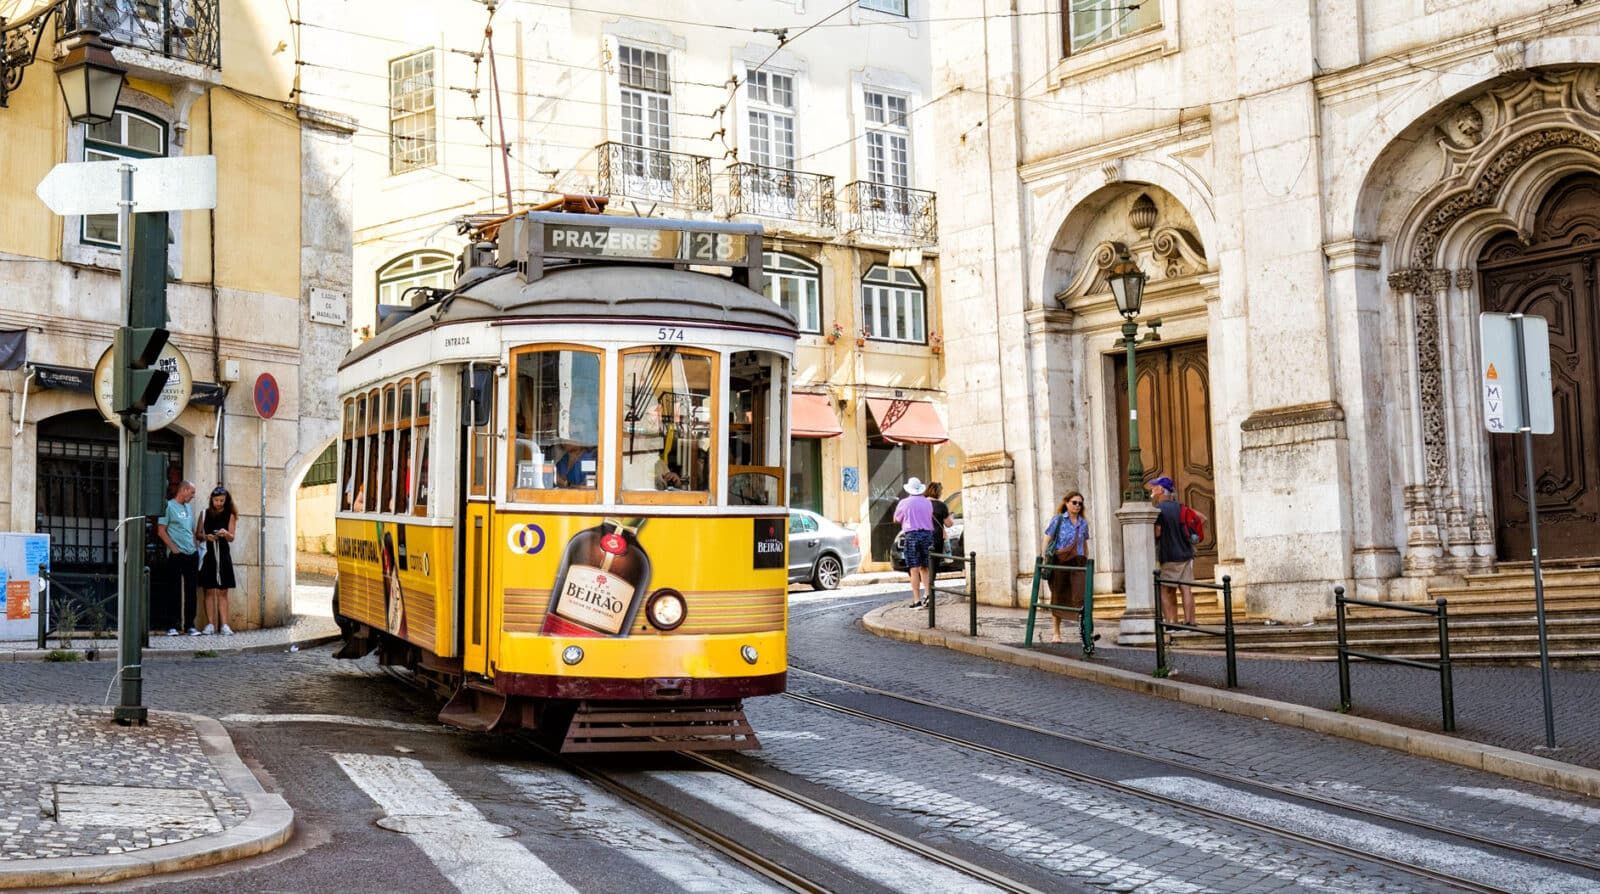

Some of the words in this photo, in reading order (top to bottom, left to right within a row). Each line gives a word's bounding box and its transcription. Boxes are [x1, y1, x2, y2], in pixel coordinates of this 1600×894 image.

[552, 229, 662, 251] PRAZERES
[696, 233, 734, 258] 28
[445, 336, 471, 347] ENTRADA
[658, 327, 684, 341] 574
[566, 581, 623, 613] BEIRÃO
